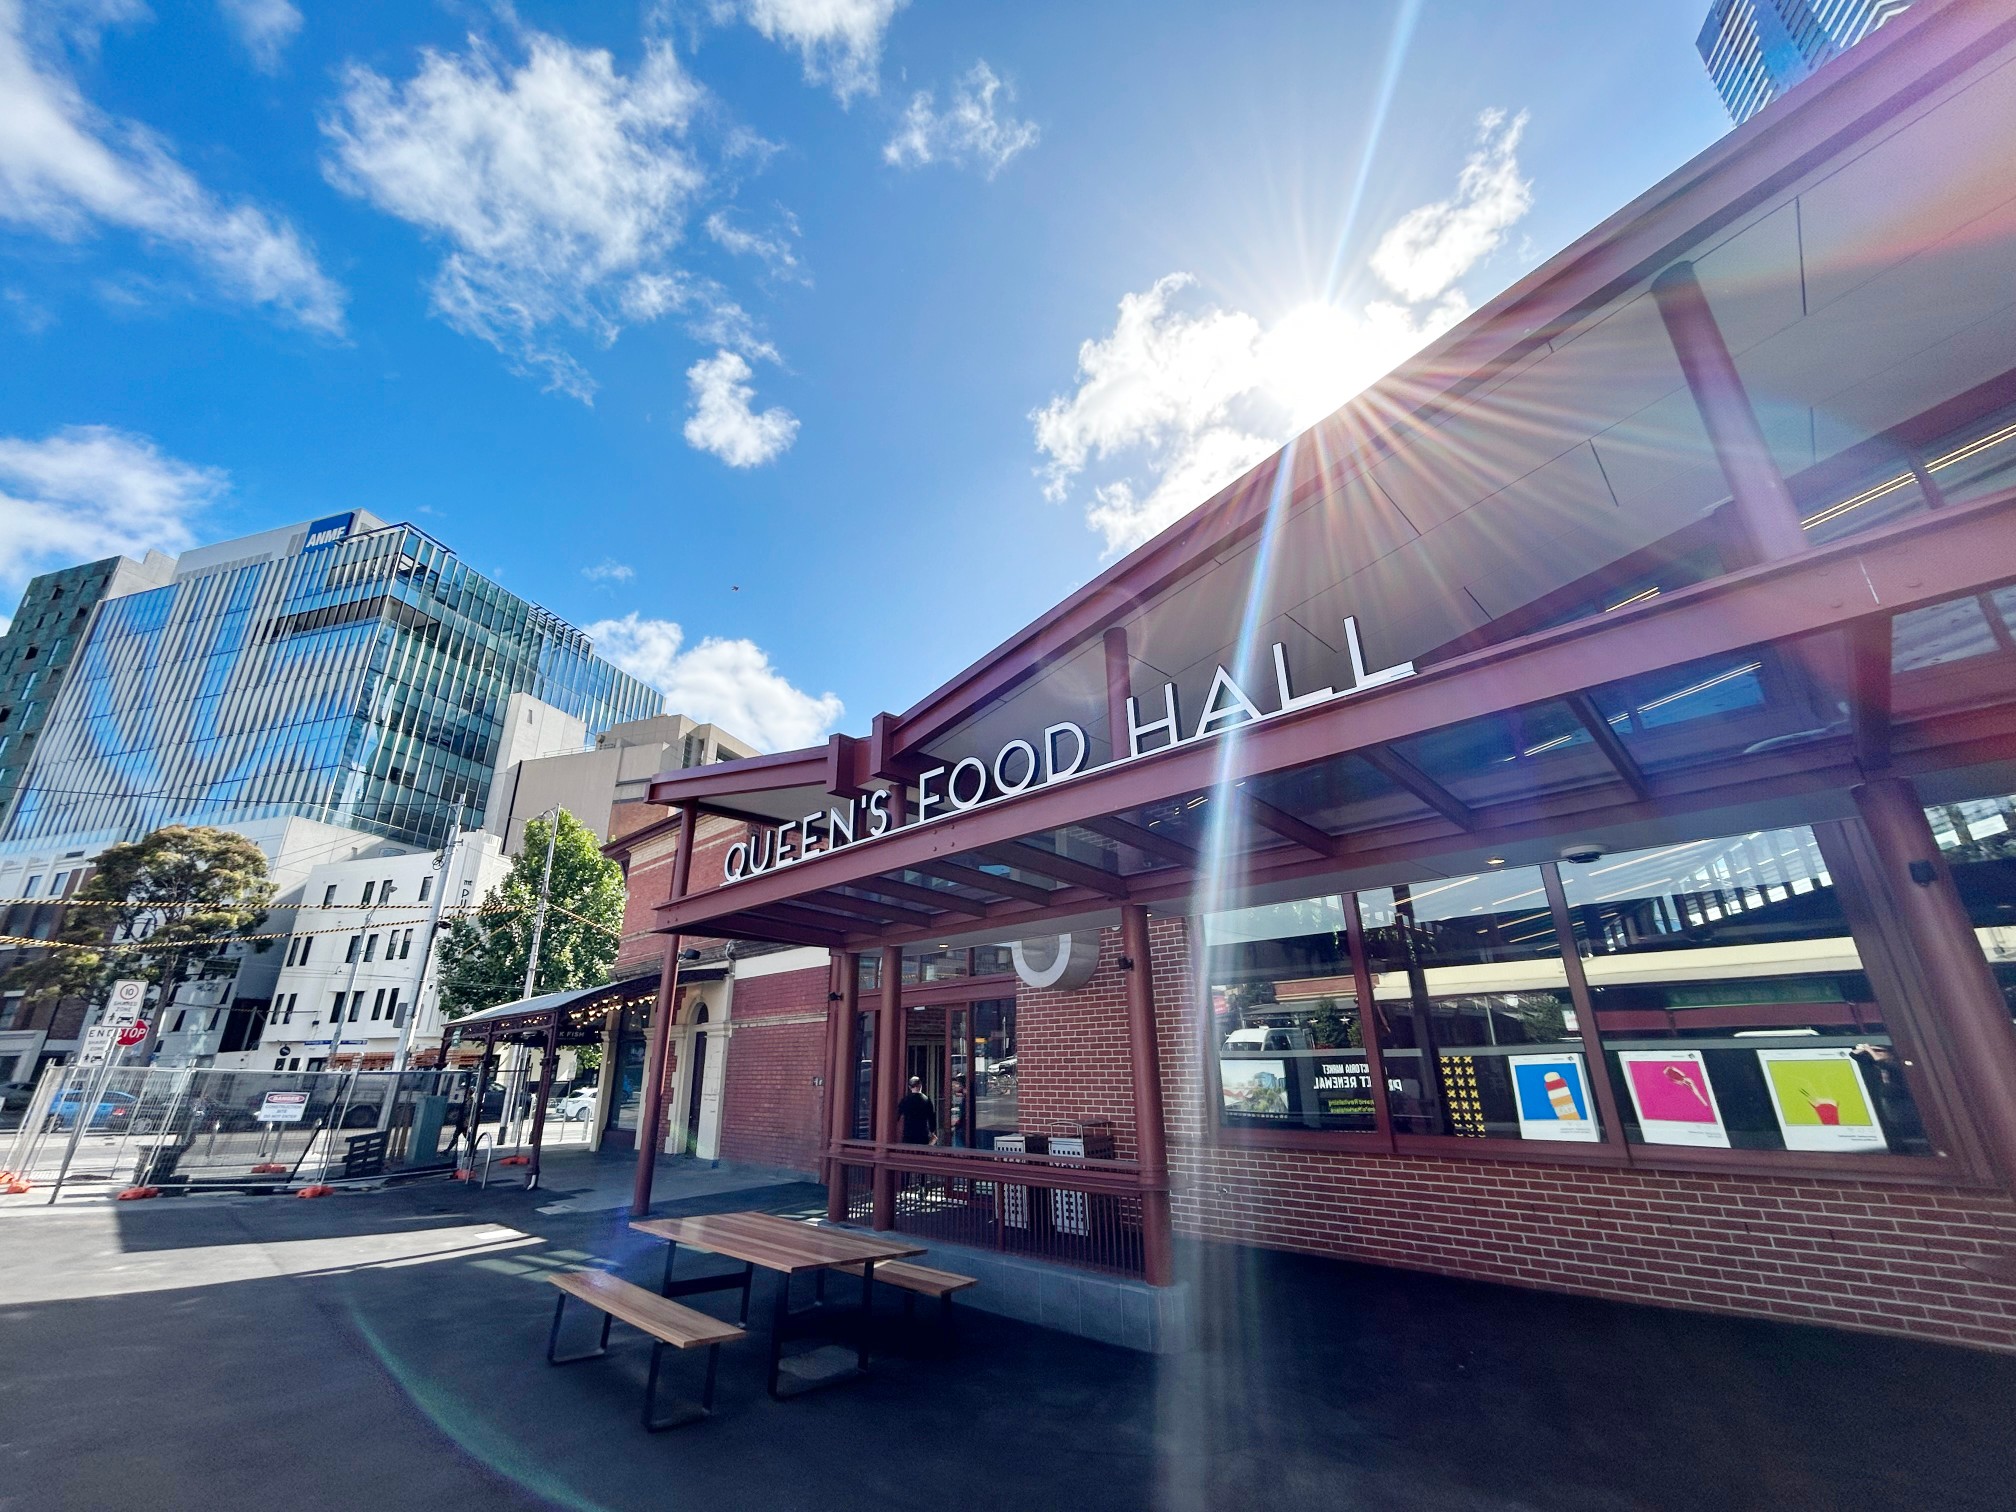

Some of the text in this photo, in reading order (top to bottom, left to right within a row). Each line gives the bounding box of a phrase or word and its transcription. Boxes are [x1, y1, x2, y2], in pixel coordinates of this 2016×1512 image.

[306, 526, 346, 547] ANMF
[723, 616, 1414, 881] QUEEN'S FOOD HALL
[125, 988, 135, 996] 10
